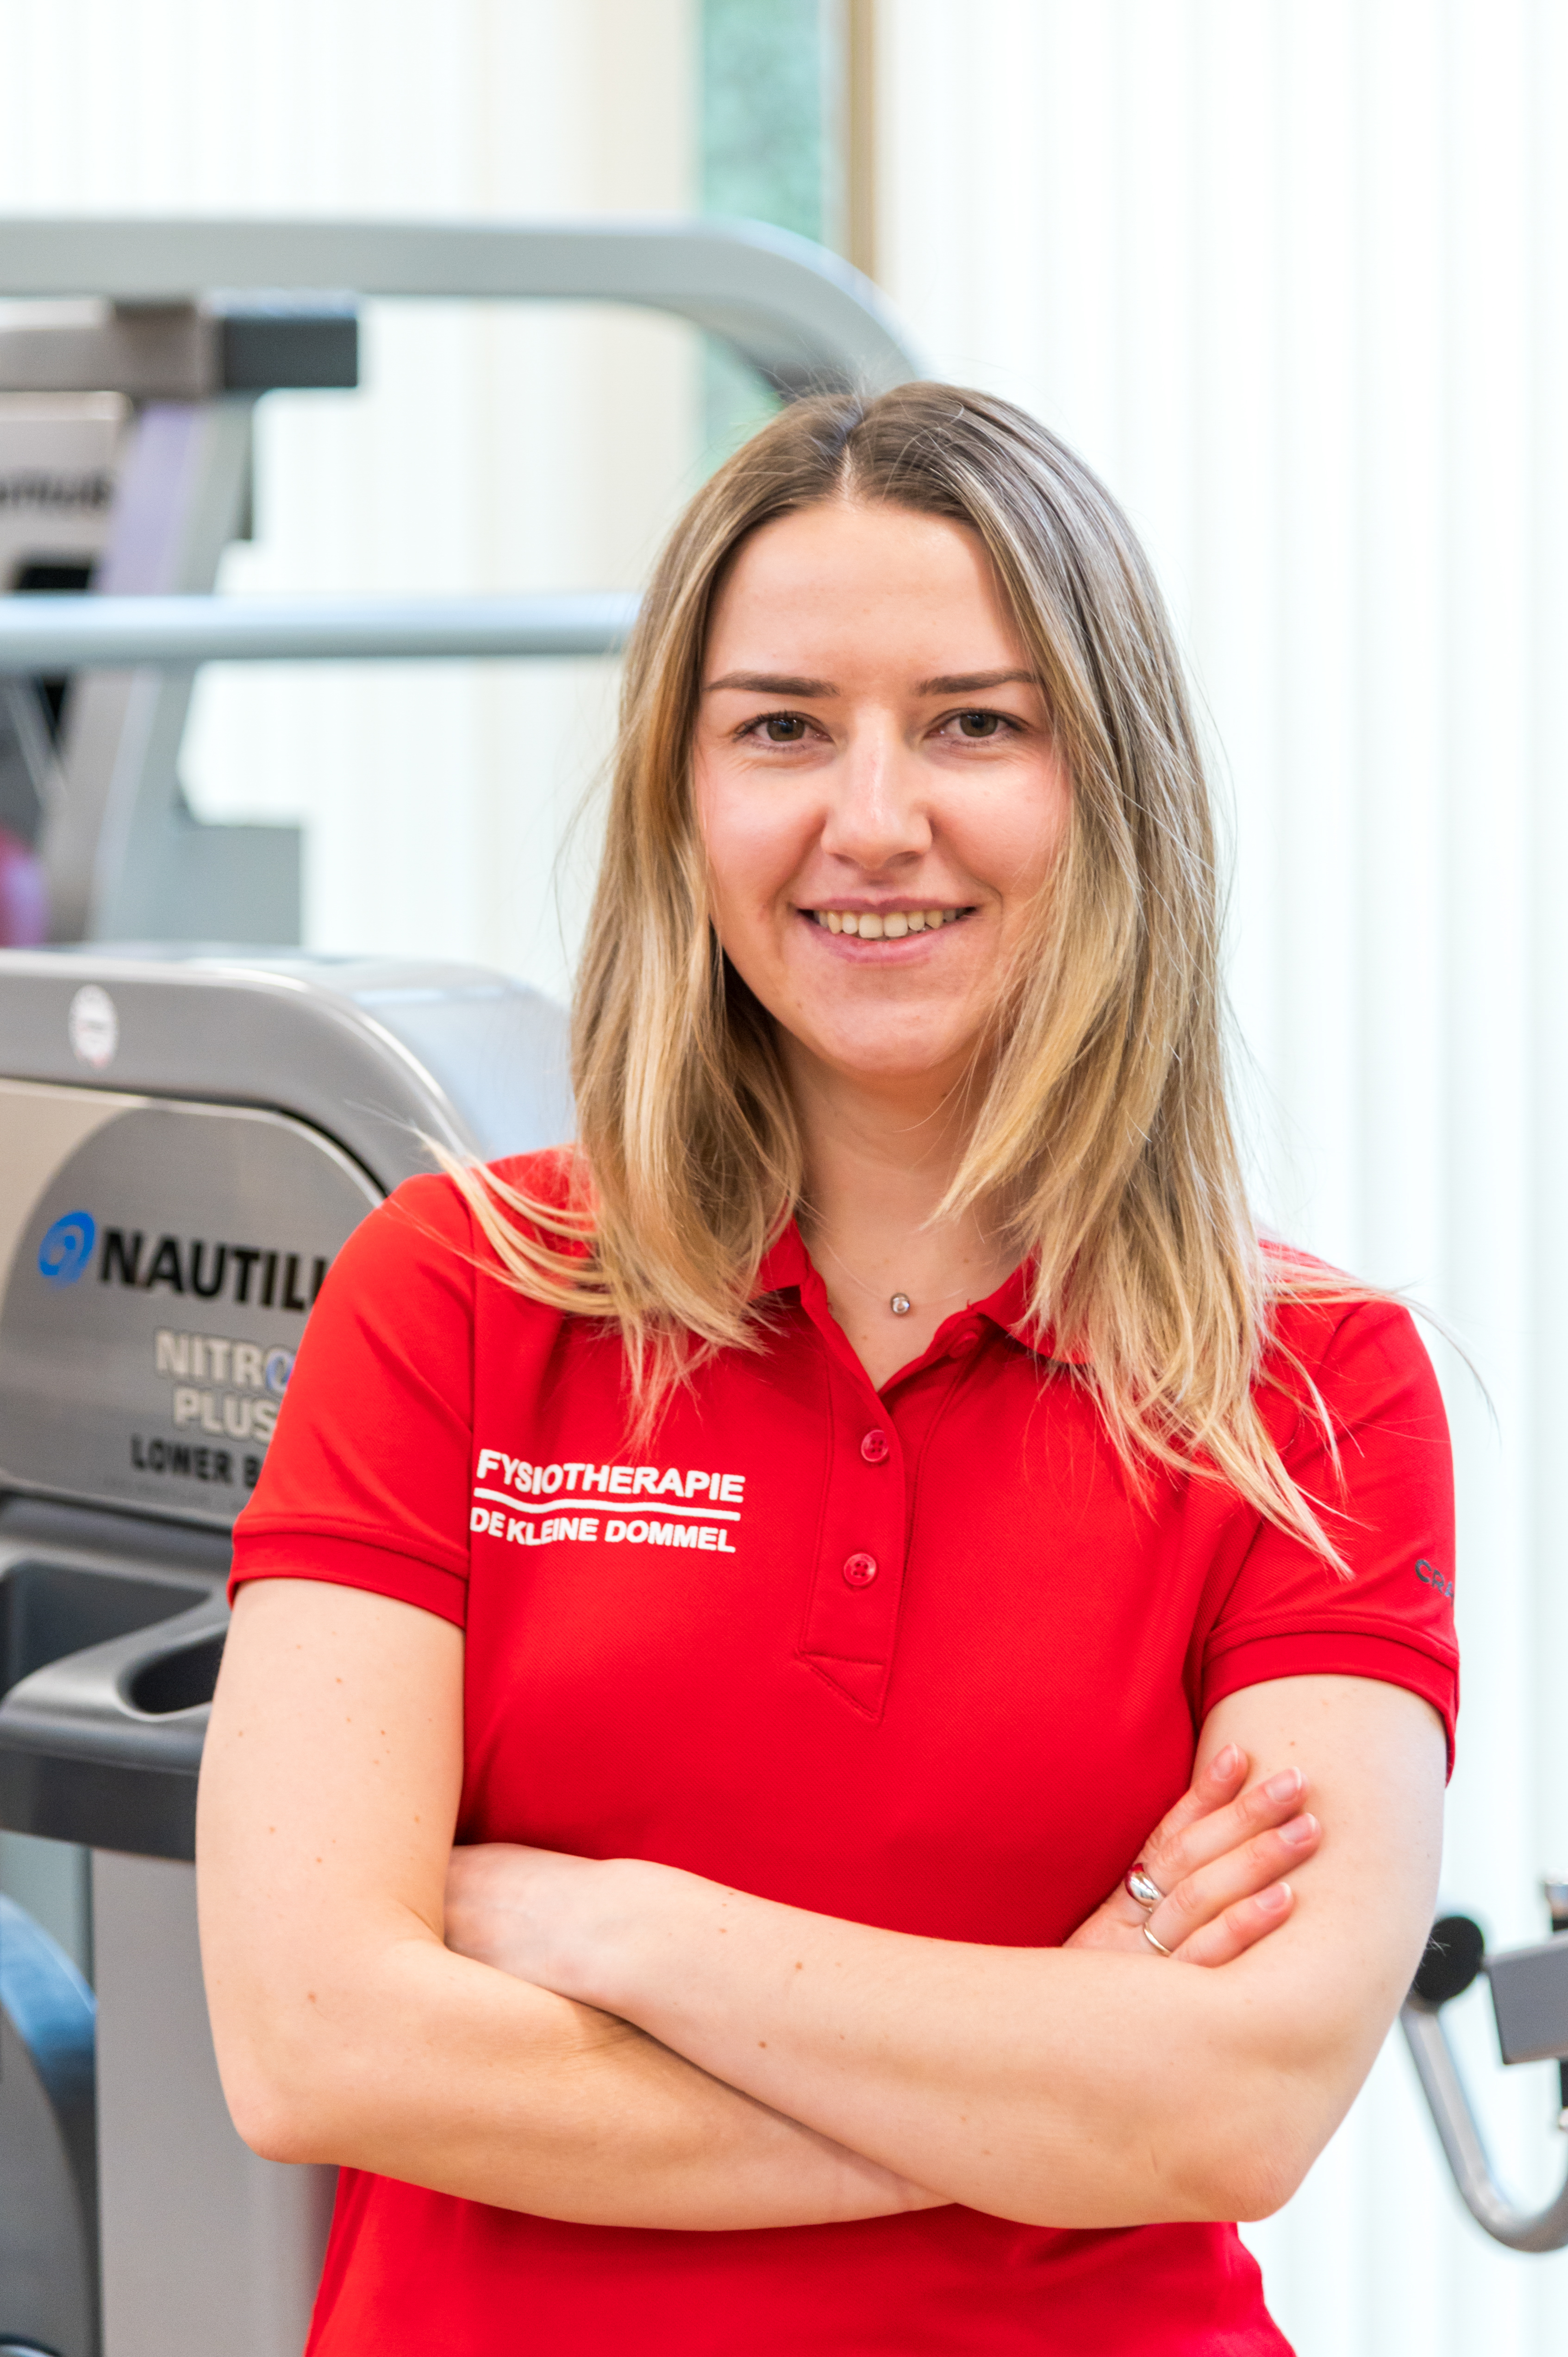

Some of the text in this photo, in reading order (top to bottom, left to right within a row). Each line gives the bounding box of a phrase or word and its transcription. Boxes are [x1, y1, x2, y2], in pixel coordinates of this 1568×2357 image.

[174, 1387, 279, 1443] PLUS
[131, 1434, 234, 1484] LOWER
[476, 1448, 746, 1503] FYSIOTHERAPIE
[469, 1507, 736, 1553] DE KLEINE DOMMEL
